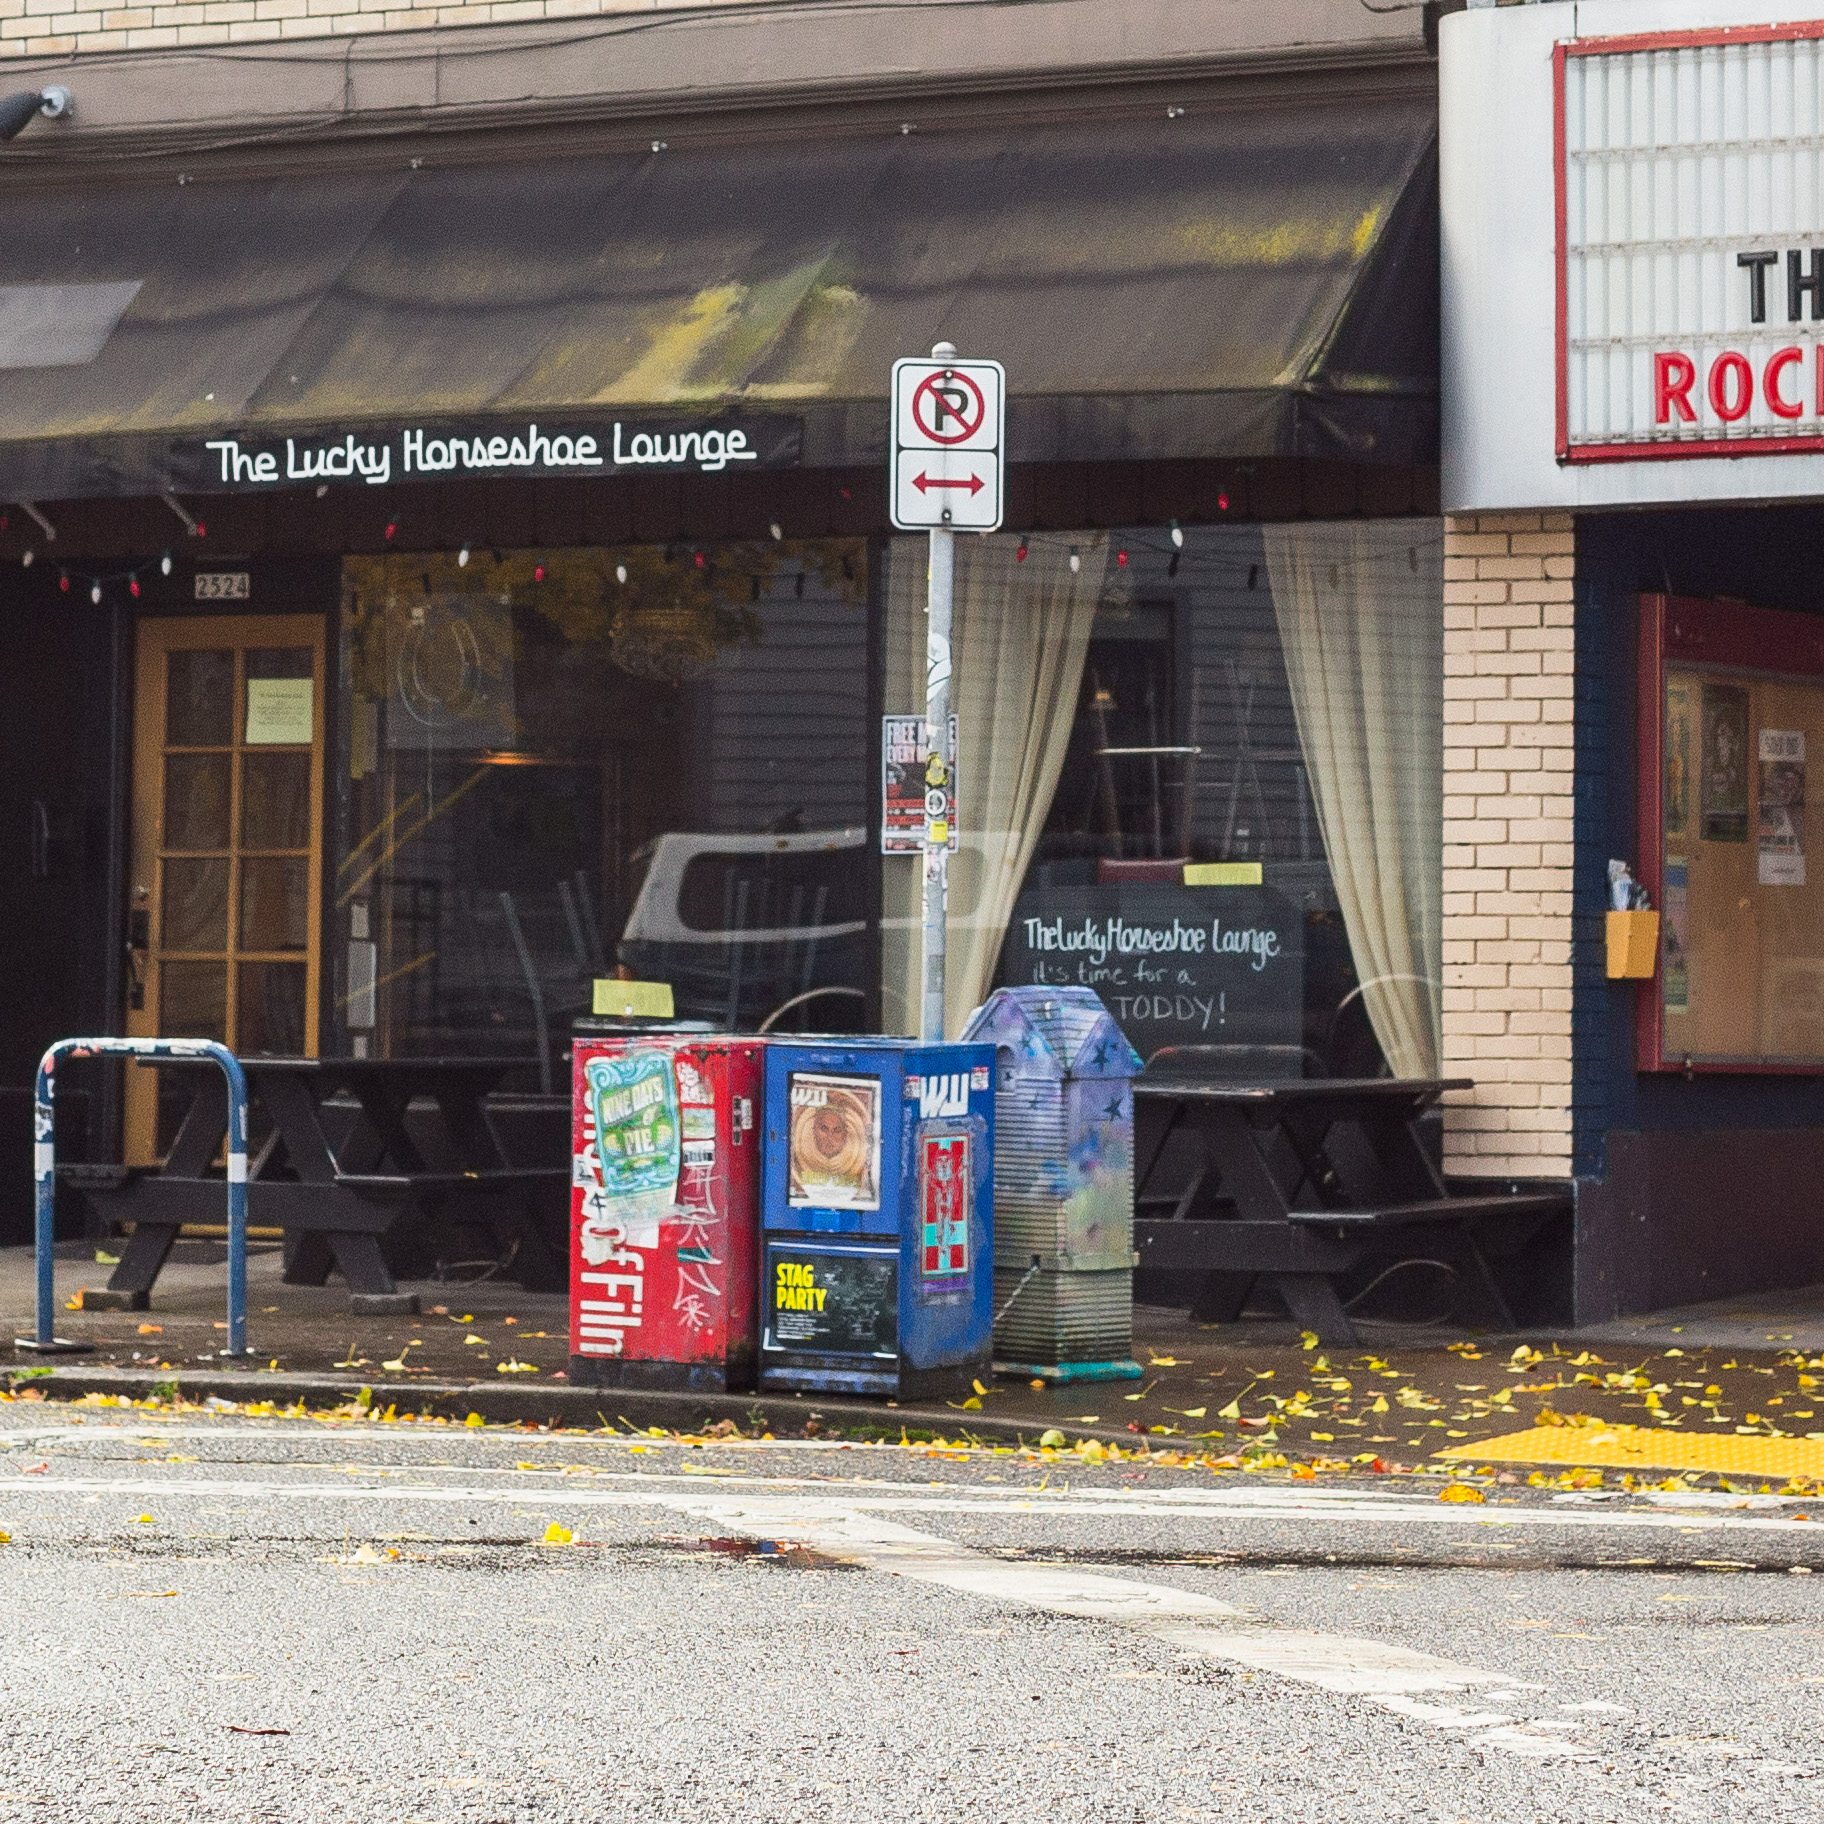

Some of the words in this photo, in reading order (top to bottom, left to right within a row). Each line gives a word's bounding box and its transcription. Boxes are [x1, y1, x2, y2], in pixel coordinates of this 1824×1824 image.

[206, 440, 279, 482] The
[286, 435, 389, 483] Lucky
[403, 424, 603, 473] Horseshoe
[614, 422, 757, 471] Lounge
[197, 576, 248, 597] 2524
[1212, 918, 1281, 971] Lounge
[1078, 959, 1128, 986] time
[1133, 959, 1169, 983] for
[1177, 968, 1197, 986] a
[1111, 992, 1226, 1031] TODDY!
[624, 1128, 655, 1156] PIE
[777, 1262, 814, 1288] STAG
[776, 1286, 828, 1311] PARTY
